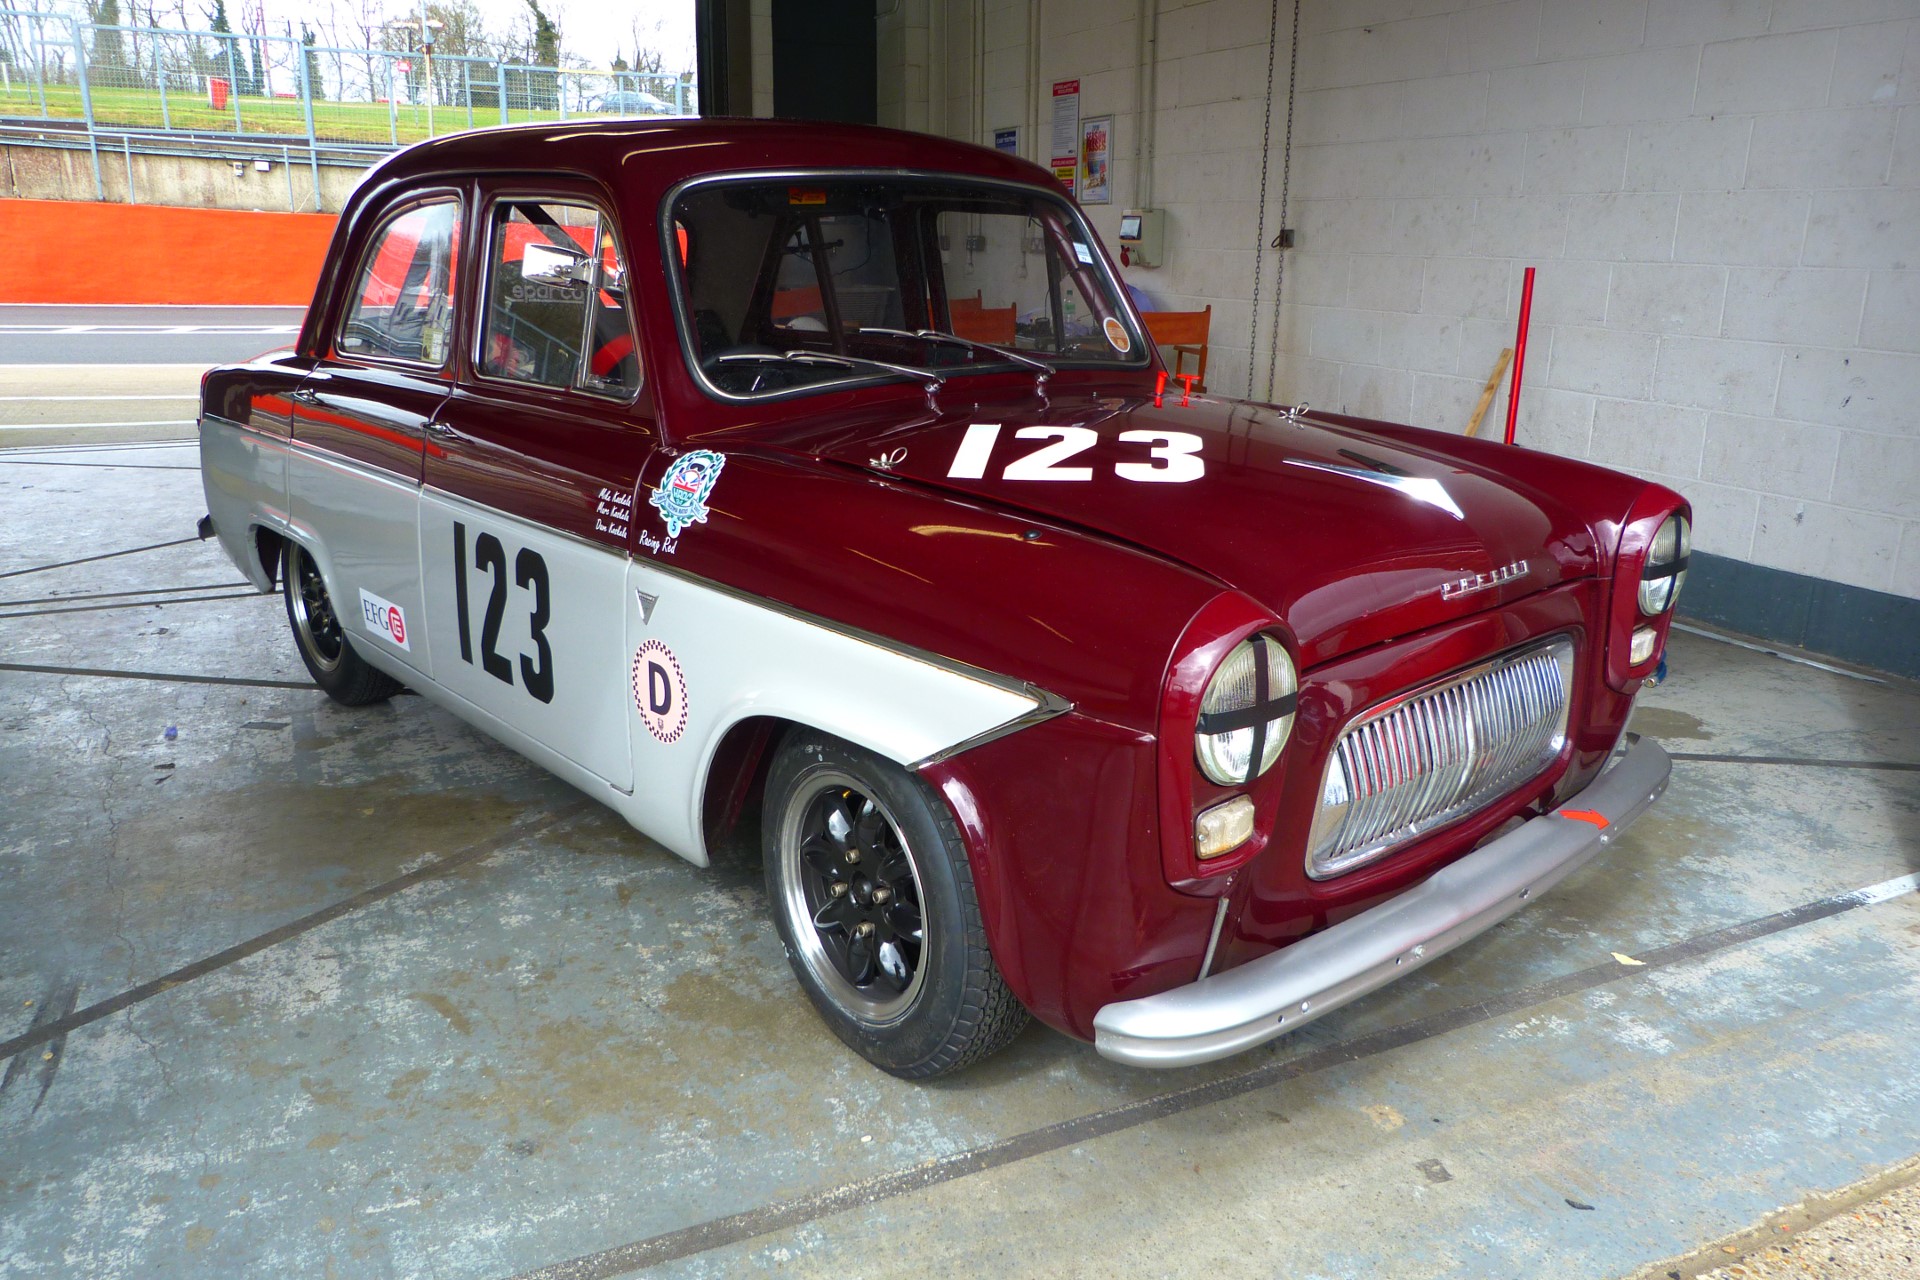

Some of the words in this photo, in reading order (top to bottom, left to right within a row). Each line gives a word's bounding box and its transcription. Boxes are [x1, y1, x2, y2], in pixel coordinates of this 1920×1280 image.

[512, 284, 584, 303] sparco
[946, 423, 1205, 483] 123
[639, 529, 660, 554] Racing
[661, 536, 678, 555] Red
[671, 520, 677, 532] 5
[1441, 560, 1529, 598] PREFECT
[363, 598, 390, 631] EFG
[453, 520, 555, 704] 123
[648, 660, 672, 716] D
